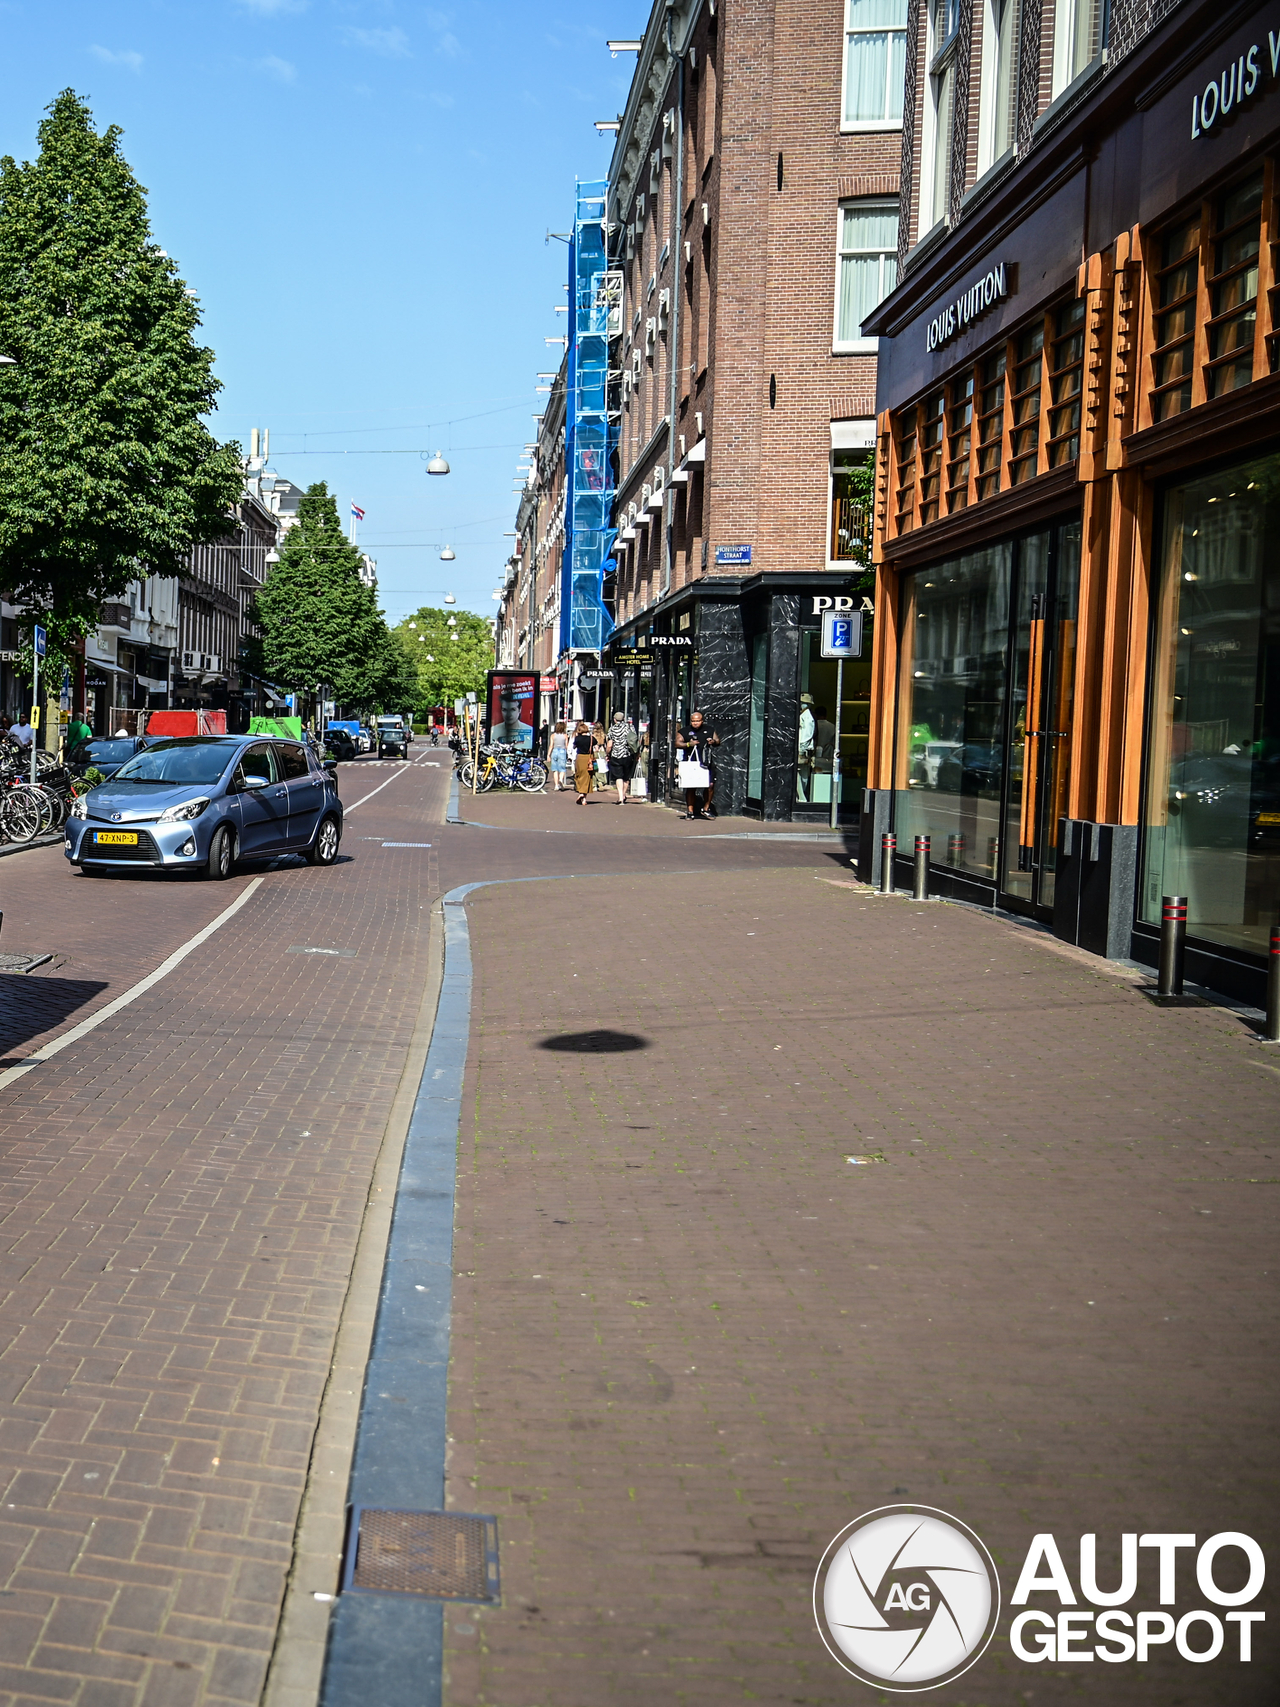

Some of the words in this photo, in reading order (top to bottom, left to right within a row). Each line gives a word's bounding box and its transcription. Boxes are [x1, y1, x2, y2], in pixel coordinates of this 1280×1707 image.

[1191, 44, 1260, 142] LOUIS
[927, 304, 956, 353] LOUIS
[957, 262, 1008, 330] VUITTON
[650, 636, 693, 645] PRADA
[99, 833, 135, 843] 47-XNP-3
